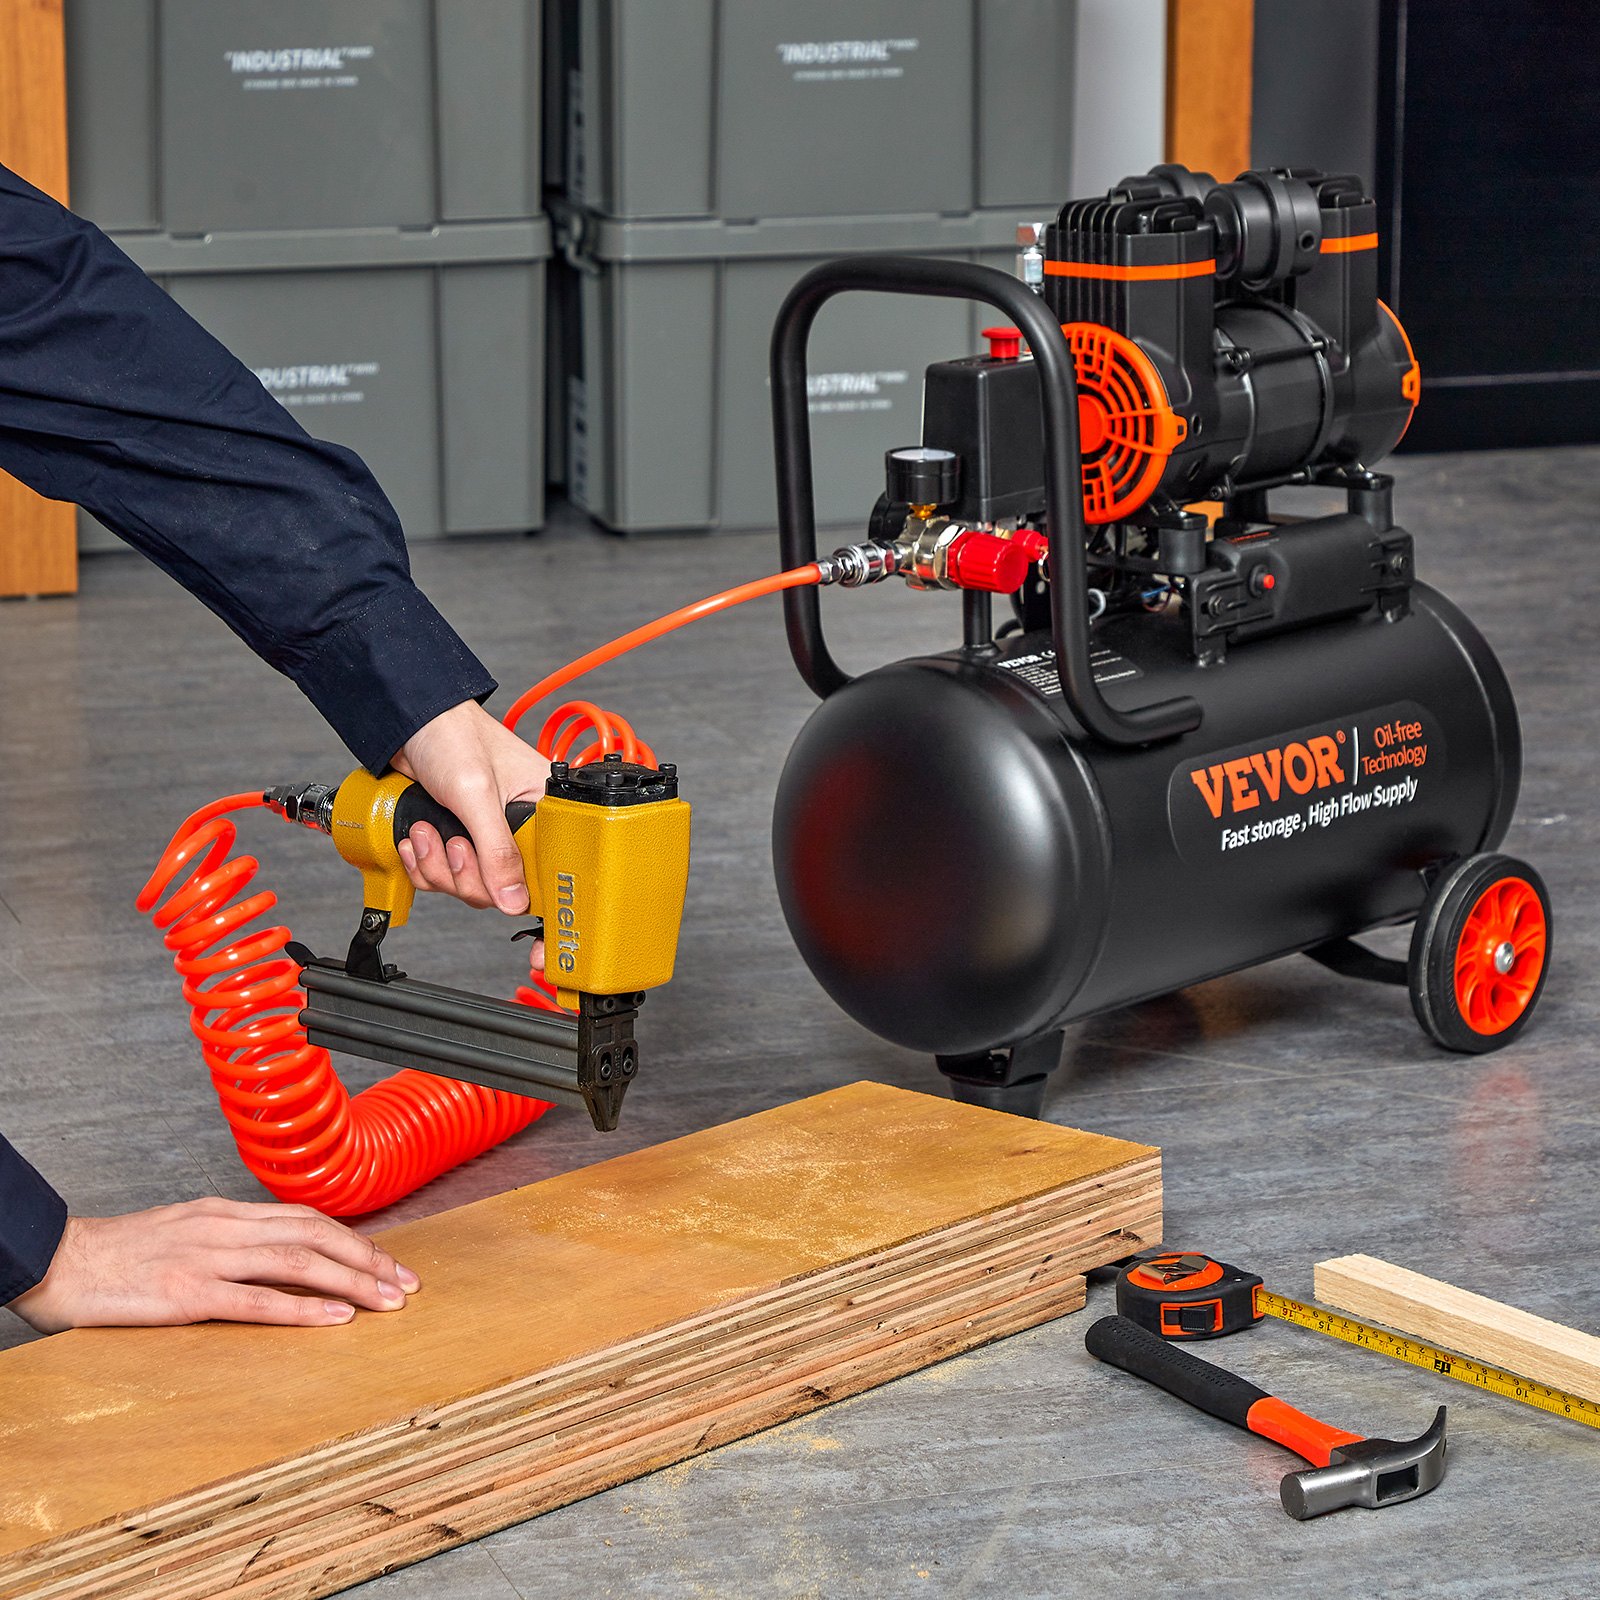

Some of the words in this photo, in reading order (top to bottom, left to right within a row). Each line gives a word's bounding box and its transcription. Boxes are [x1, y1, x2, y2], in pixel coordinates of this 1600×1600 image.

[1361, 744, 1428, 776] Technology
[1373, 719, 1422, 748] Oil-free
[1221, 825, 1250, 851] Fast
[1309, 797, 1339, 827] High
[1341, 788, 1373, 817] Flow
[1373, 775, 1418, 808] Supply
[557, 872, 580, 973] meite
